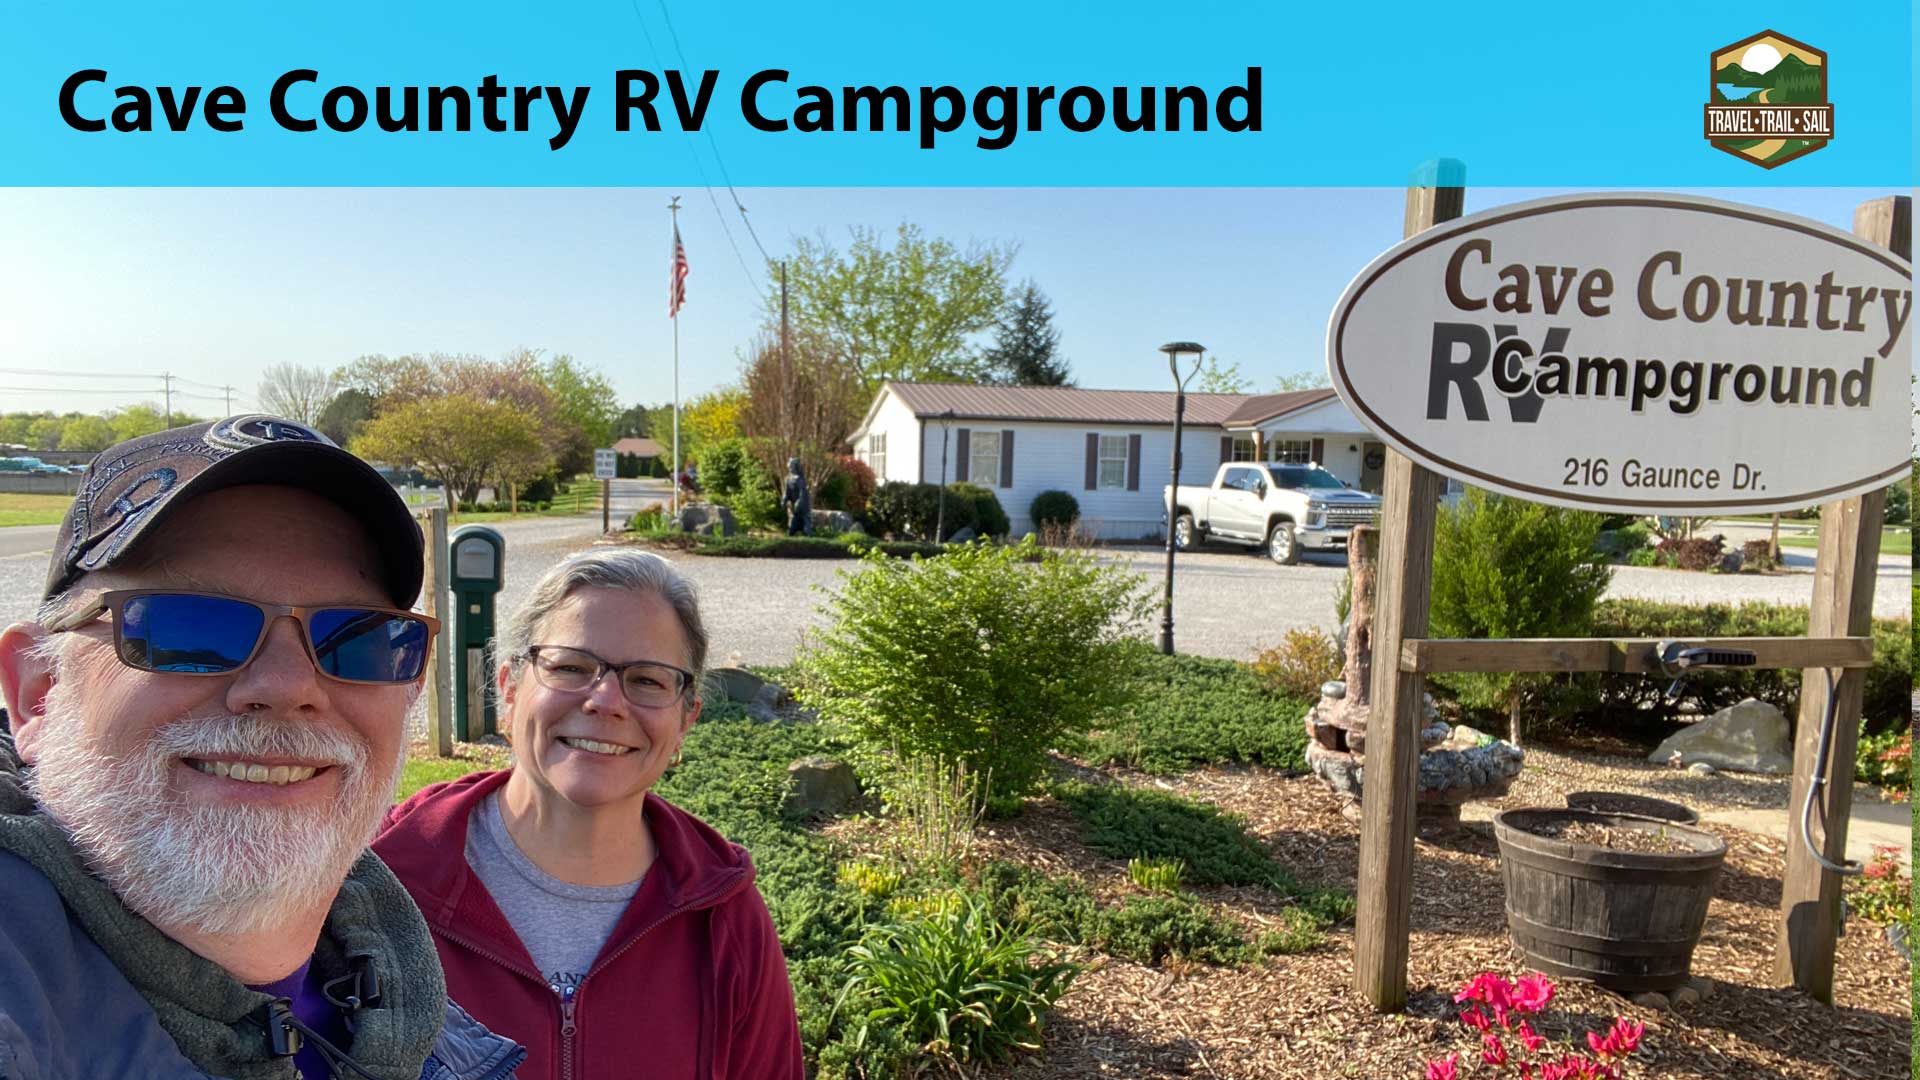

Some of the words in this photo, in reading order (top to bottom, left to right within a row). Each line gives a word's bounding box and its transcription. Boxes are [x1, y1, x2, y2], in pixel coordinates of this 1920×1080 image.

[1445, 238, 1614, 317] Cave
[1637, 251, 1912, 359] Country
[1426, 321, 1571, 423] RV
[1492, 338, 1876, 414] Campground
[1563, 457, 1609, 486] 216
[1621, 459, 1720, 489] Gaunce
[1732, 463, 1766, 490] Dr.
